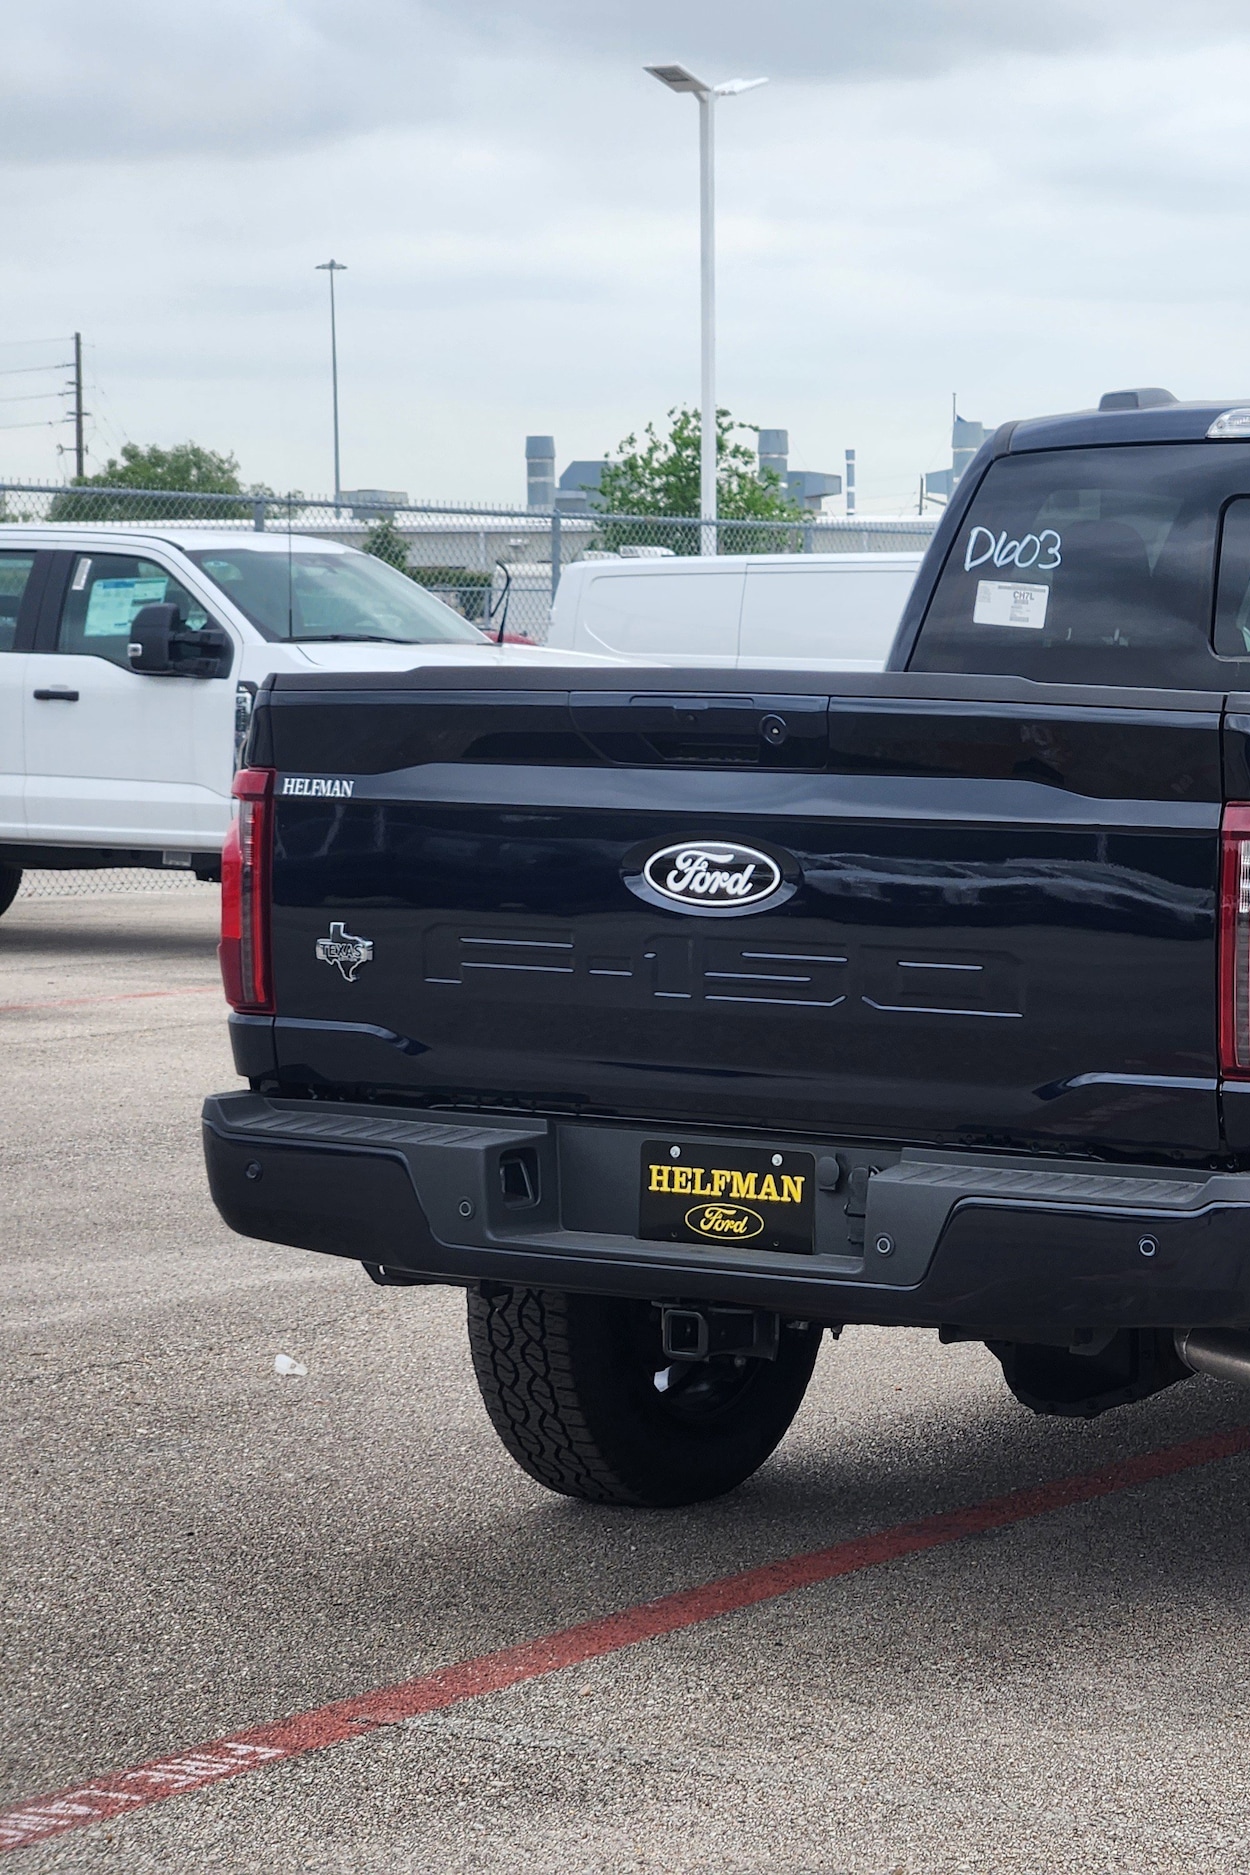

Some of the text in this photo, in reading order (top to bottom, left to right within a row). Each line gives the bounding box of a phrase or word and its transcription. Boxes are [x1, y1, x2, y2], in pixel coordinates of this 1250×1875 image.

[1013, 591, 1034, 600] CH7L
[282, 777, 355, 798] HELFMAN
[666, 849, 757, 897] Ford
[320, 943, 363, 959] TEXAS
[648, 1164, 806, 1204] HELFMAN
[700, 1206, 750, 1234] Ford
